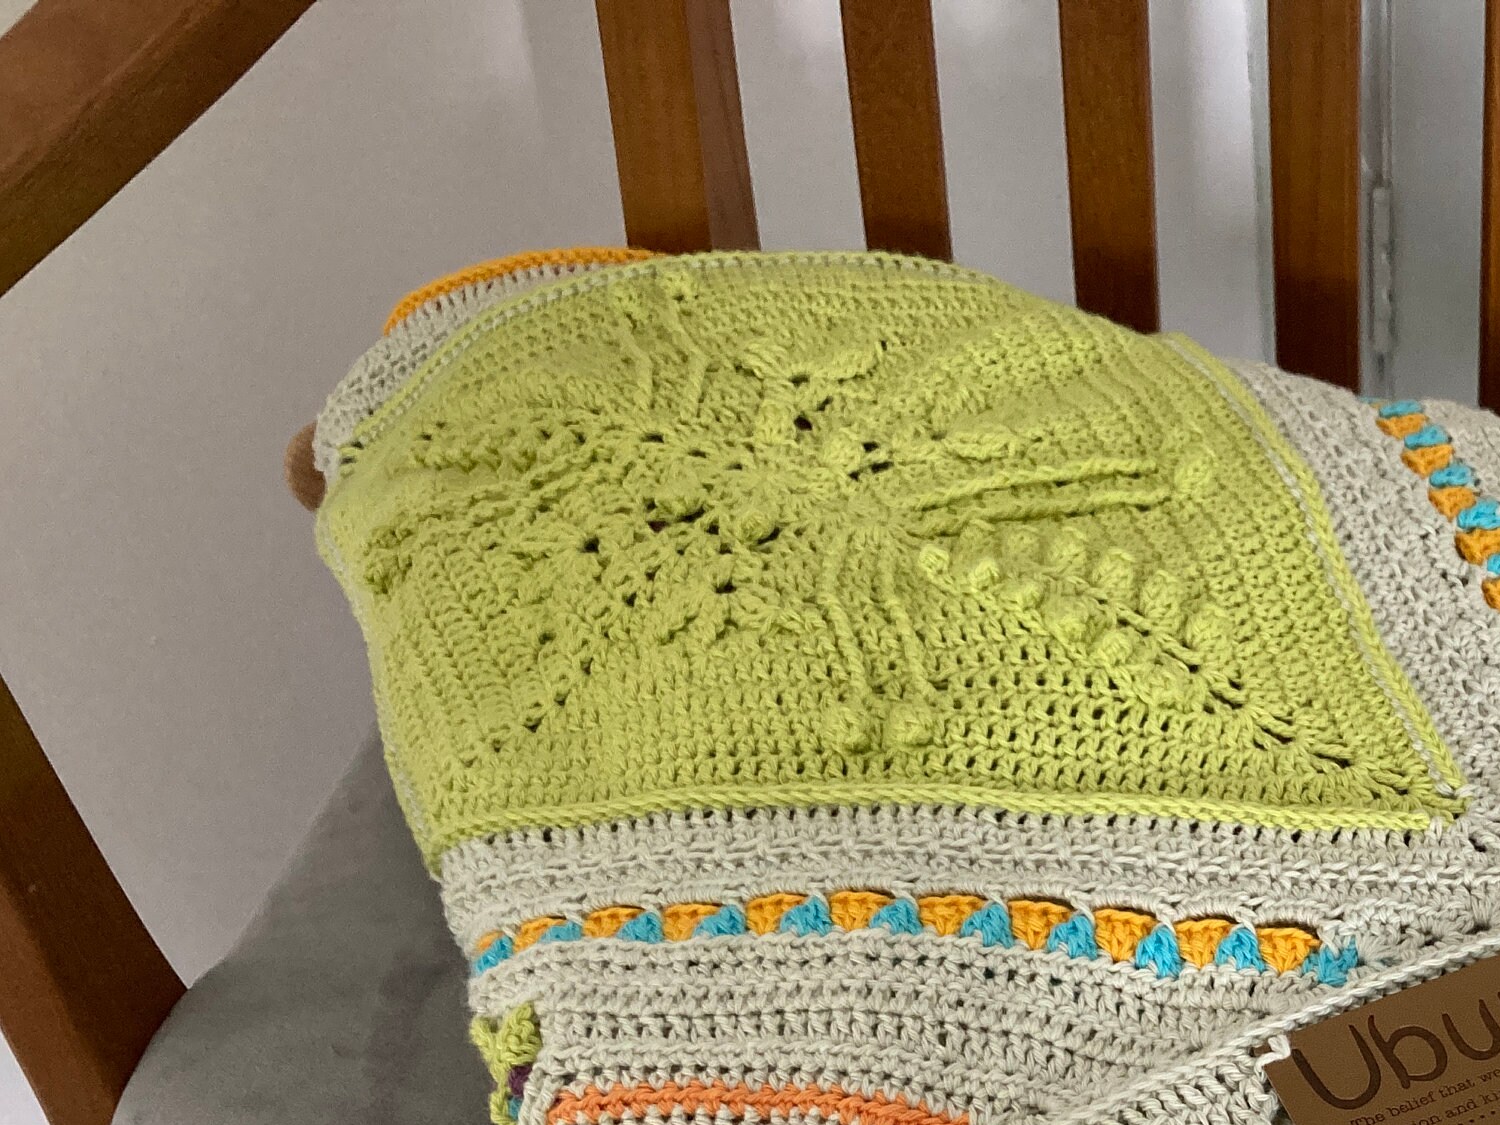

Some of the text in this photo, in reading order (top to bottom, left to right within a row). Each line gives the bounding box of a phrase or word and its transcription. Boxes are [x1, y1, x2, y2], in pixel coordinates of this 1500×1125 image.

[1387, 1091, 1436, 1117] belief
[1438, 1077, 1475, 1098] that
[1445, 1099, 1479, 1119] and
